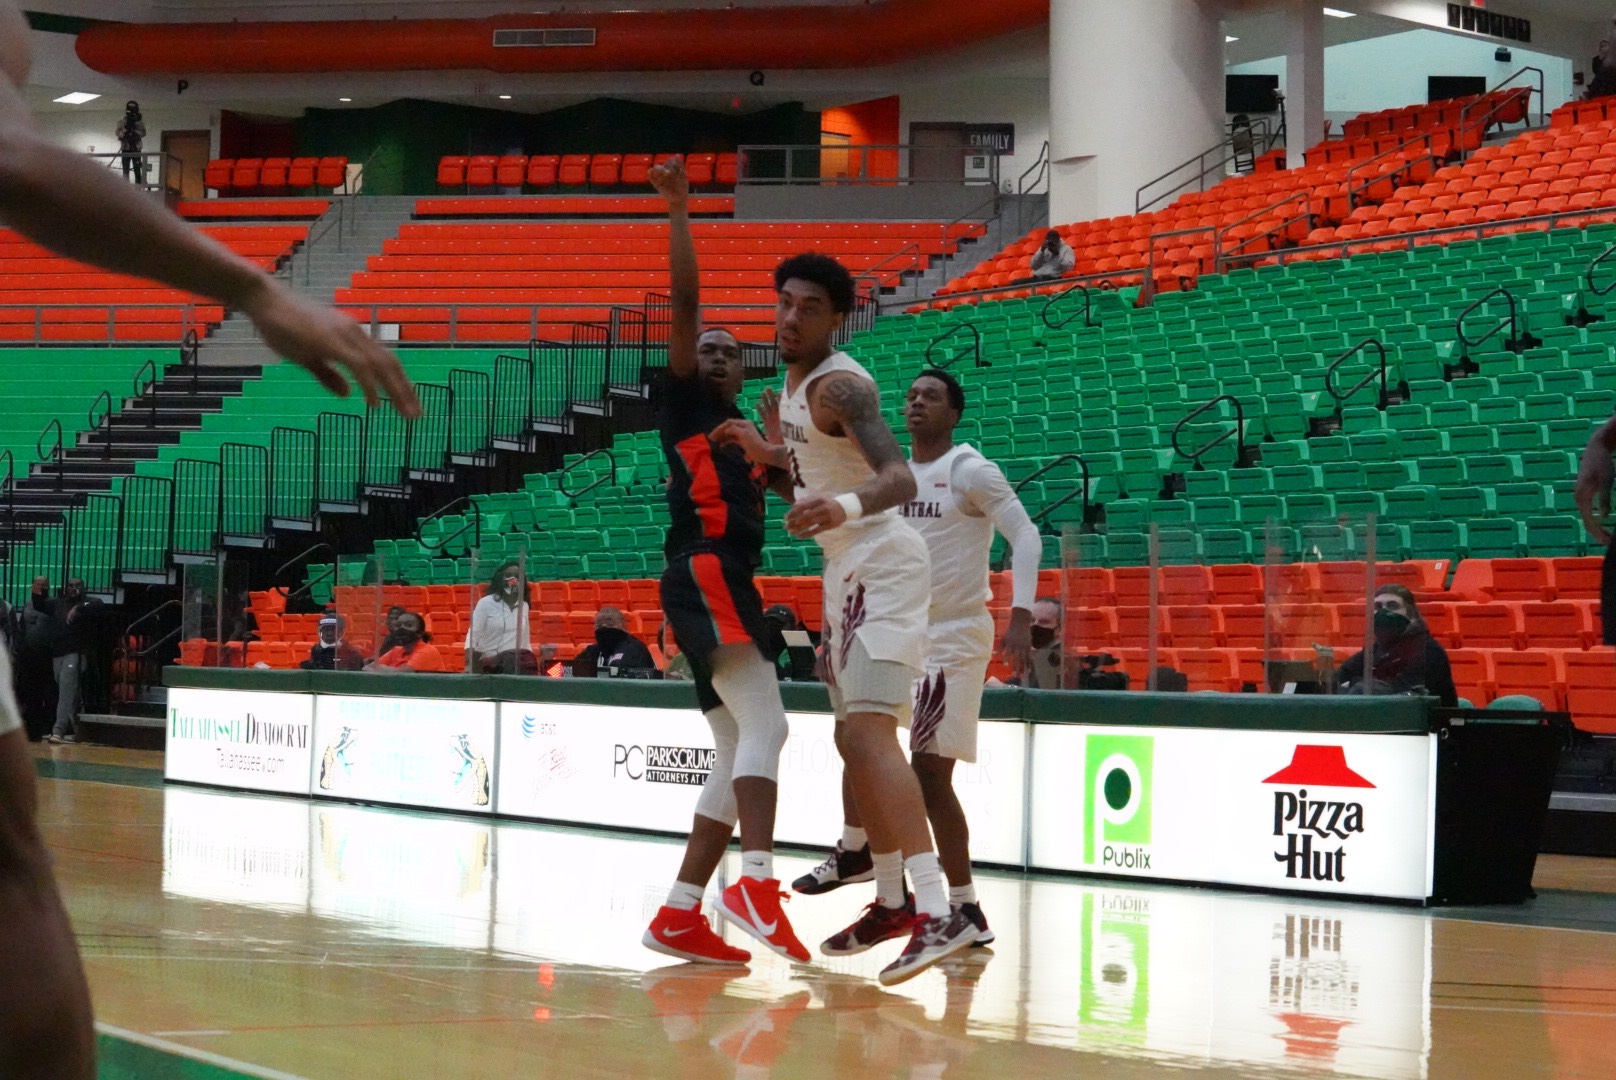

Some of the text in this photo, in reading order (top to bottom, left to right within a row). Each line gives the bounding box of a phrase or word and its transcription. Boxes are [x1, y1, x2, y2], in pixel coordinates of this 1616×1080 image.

[177, 79, 189, 95] P
[749, 70, 764, 87] Q
[246, 712, 309, 749] DEMOCRAT
[613, 743, 644, 780] PC
[646, 770, 689, 784] ATTORNEYS
[690, 773, 700, 784] AT
[1273, 789, 1364, 840] Pizza
[1103, 845, 1151, 869] Publix
[1274, 834, 1346, 882] Hut
